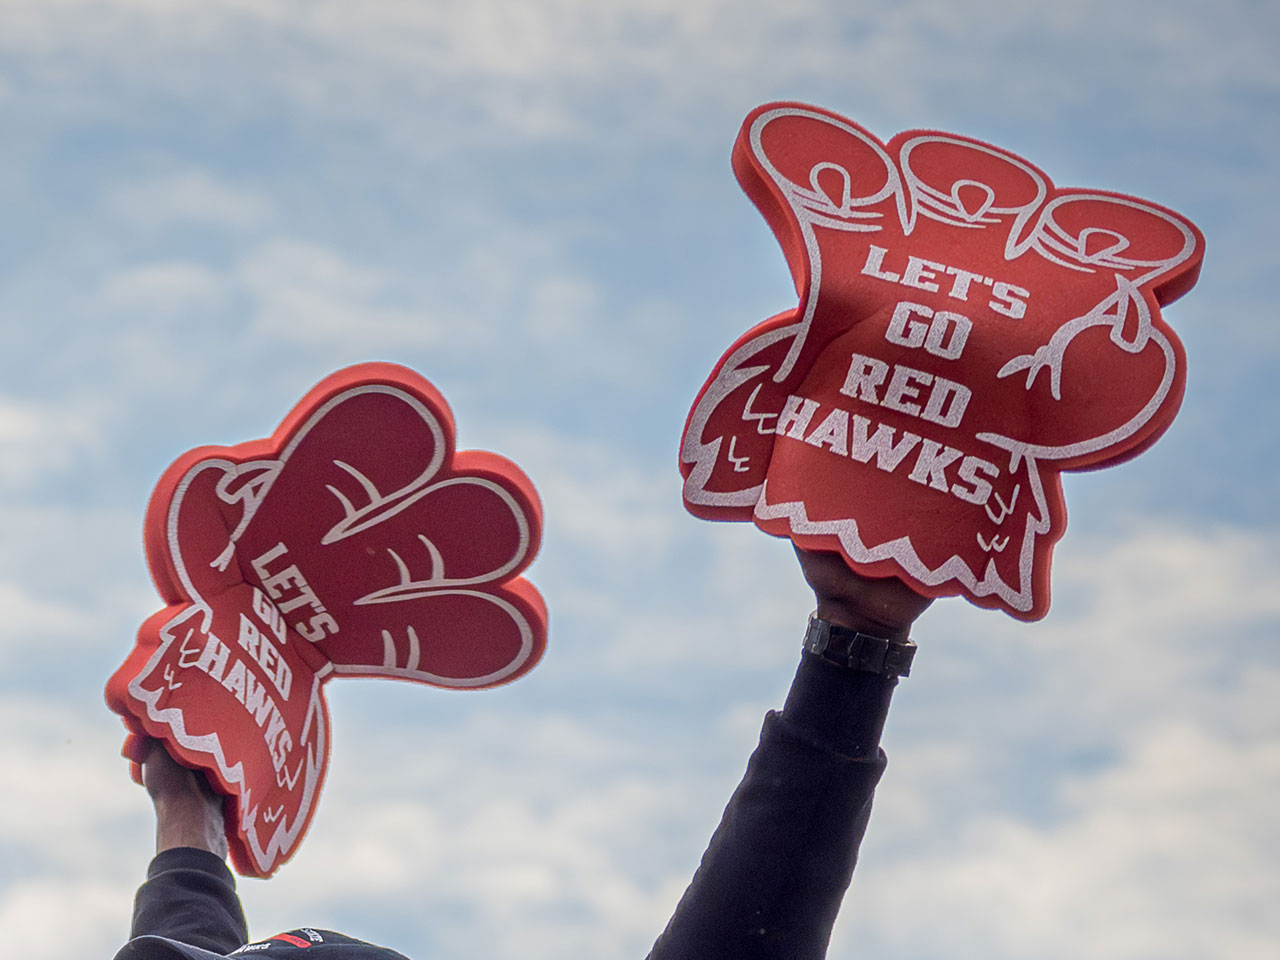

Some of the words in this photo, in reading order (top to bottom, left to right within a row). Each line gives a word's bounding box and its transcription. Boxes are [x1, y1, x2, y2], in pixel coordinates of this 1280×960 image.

[860, 244, 1030, 319] LET'S
[885, 301, 973, 361] GO
[839, 353, 972, 428] RED
[776, 395, 1001, 506] HAWKS
[250, 542, 340, 643] LET'S
[237, 612, 293, 701] RED
[195, 631, 293, 773] HAWKS
